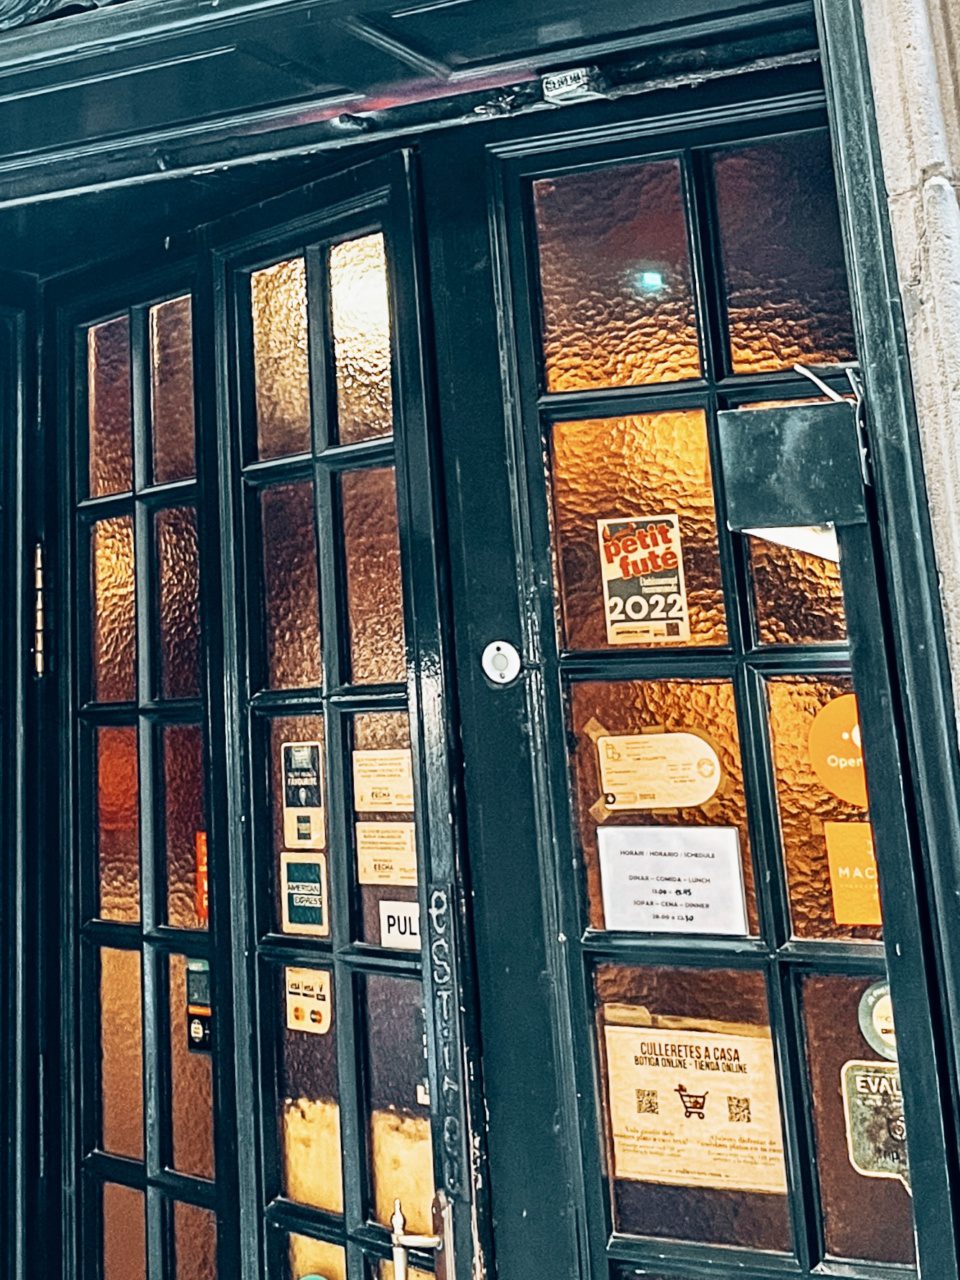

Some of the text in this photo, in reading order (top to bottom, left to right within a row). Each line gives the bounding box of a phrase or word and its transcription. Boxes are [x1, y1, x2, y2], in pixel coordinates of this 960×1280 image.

[604, 523, 673, 565] petit
[620, 546, 679, 579] futé
[608, 593, 684, 621] 2022
[288, 884, 320, 894] AMERICAN
[640, 1041, 740, 1062] CULLERETES A CASA
[634, 1055, 660, 1067] BOTIGA
[661, 1058, 687, 1069] ONLINE
[694, 1060, 720, 1071] TIENDA
[721, 1062, 747, 1074] ONLINE
